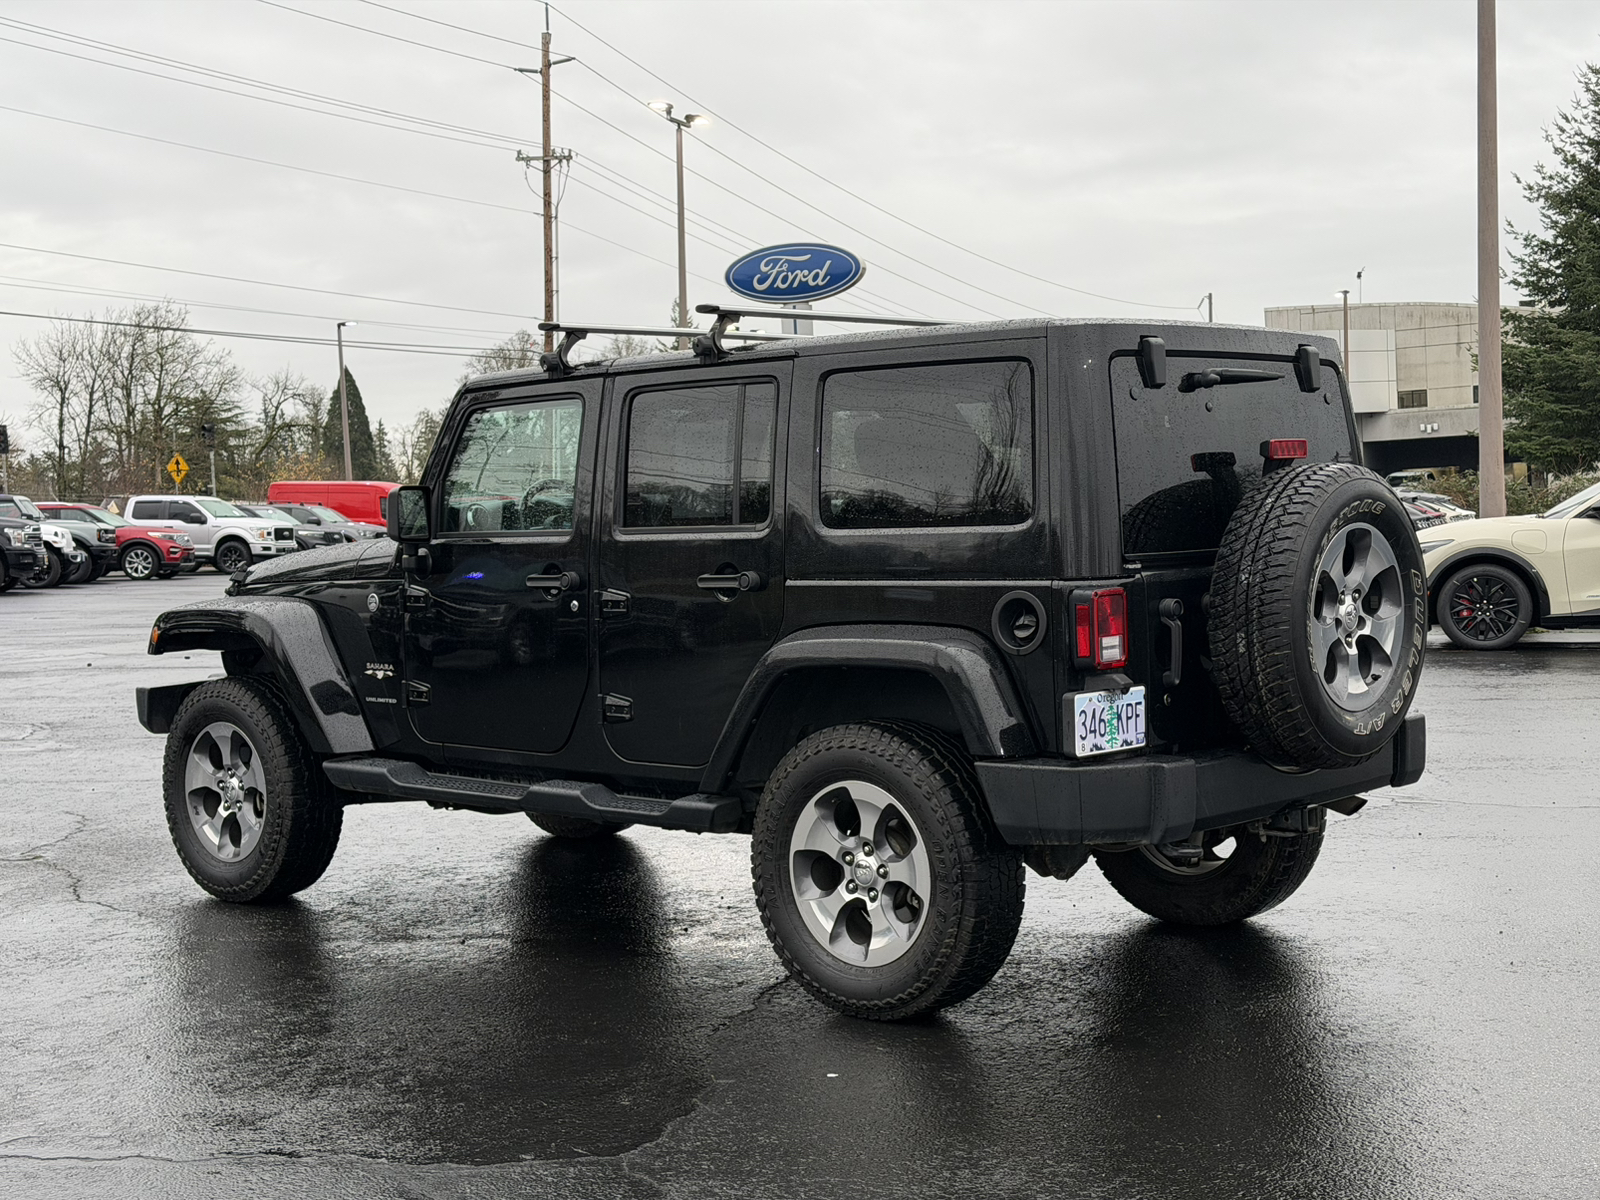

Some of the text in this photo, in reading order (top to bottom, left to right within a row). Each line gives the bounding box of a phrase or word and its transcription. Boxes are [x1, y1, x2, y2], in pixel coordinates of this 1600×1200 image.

[753, 254, 832, 291] Ford
[1097, 693, 1124, 704] Oregon
[1079, 701, 1143, 740] 346 KPF
[1354, 712, 1386, 735] A/T
